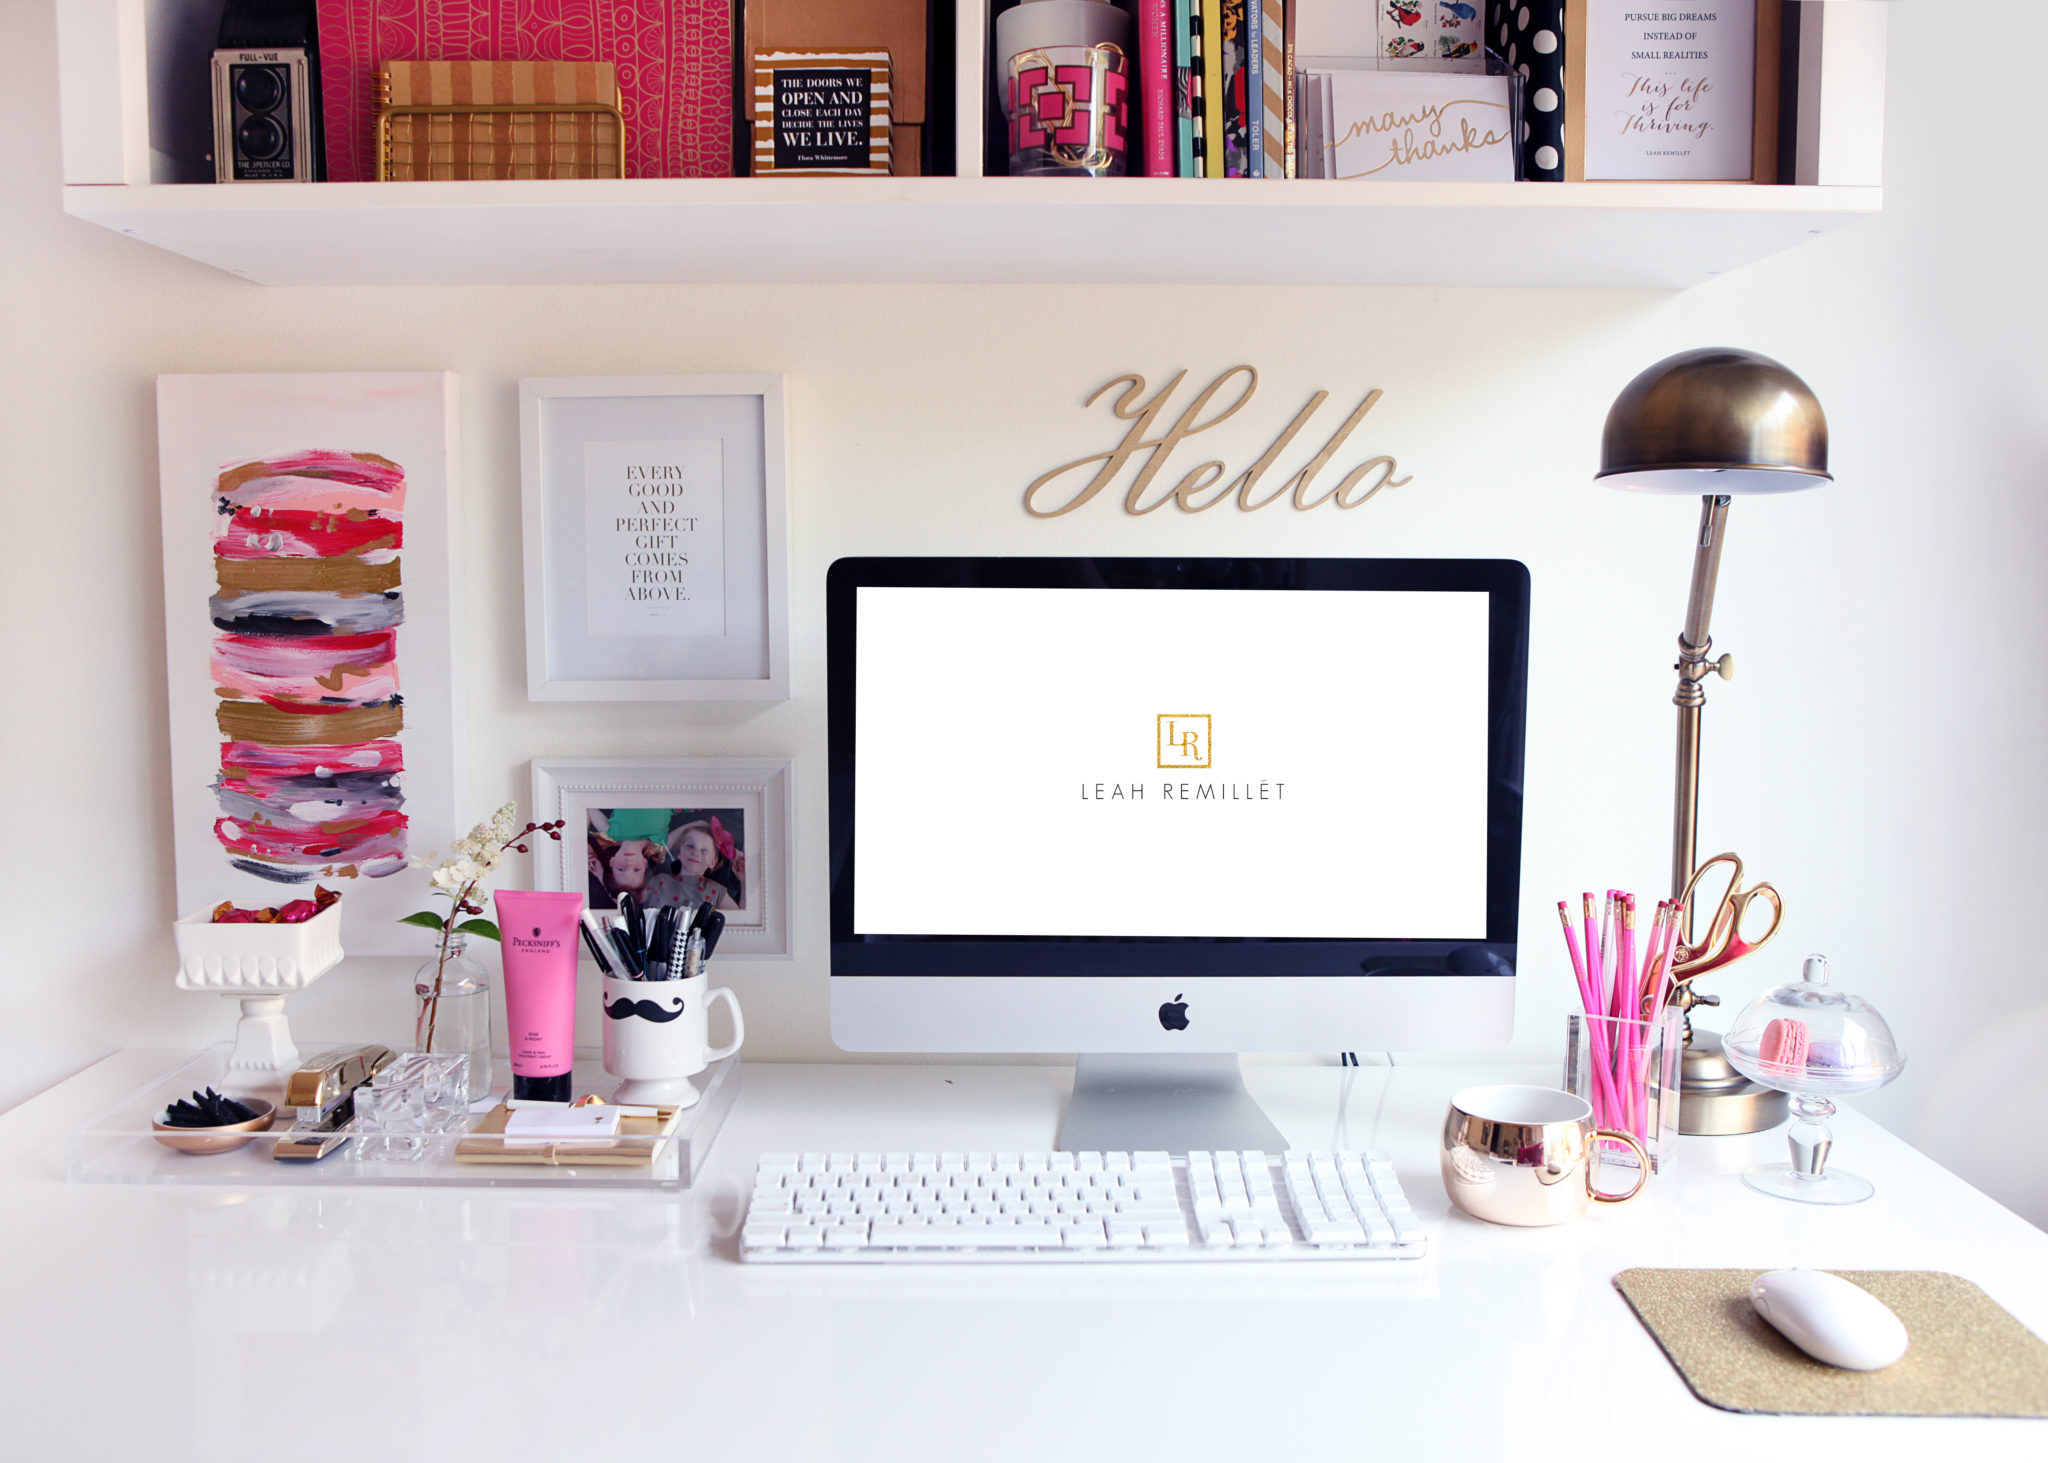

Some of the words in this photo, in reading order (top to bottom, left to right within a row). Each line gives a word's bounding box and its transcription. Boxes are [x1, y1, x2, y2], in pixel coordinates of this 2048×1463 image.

[1624, 13, 1660, 22] PURSUE
[1661, 13, 1677, 21] BIG
[1679, 13, 1717, 21] DREAMS
[1643, 32, 1683, 40] INSTEAD
[1684, 32, 1698, 40] OF
[1160, 20, 1168, 80] MILLIONAIRE
[1251, 39, 1259, 75] LEADERS
[1631, 51, 1662, 60] SMALL
[1663, 51, 1709, 60] REALITIES
[781, 78, 803, 88] THE
[806, 77, 843, 88] DOORS
[846, 77, 863, 87] WE
[1622, 72, 1672, 97] This
[1680, 76, 1714, 102] life
[781, 91, 825, 106] OPEN
[829, 91, 863, 105] AND
[781, 108, 813, 118] CLOSE
[815, 108, 841, 117] EACH
[844, 108, 864, 117] DAY
[1641, 100, 1660, 116] is
[1665, 96, 1696, 121] for
[782, 120, 814, 129] DECIDE
[818, 119, 835, 128] THE
[838, 119, 864, 128] LIVES
[782, 132, 812, 147] WE
[816, 131, 863, 147] LIVE.
[1252, 120, 1260, 151] TOLER
[238, 161, 250, 169] THE
[1022, 364, 1414, 518] Hello
[626, 465, 686, 480] EVERY
[628, 483, 684, 497] GOOD
[637, 500, 676, 514] AND
[616, 517, 698, 532] PERFECT
[635, 535, 679, 549] GIFT
[625, 552, 689, 567] COMES
[631, 569, 683, 584] FROM
[624, 586, 691, 601] ABOVE.
[1081, 783, 1144, 800] LEAH
[1163, 779, 1286, 800] REMILLÉT
[512, 936, 561, 948] PECKSNIFF'S
